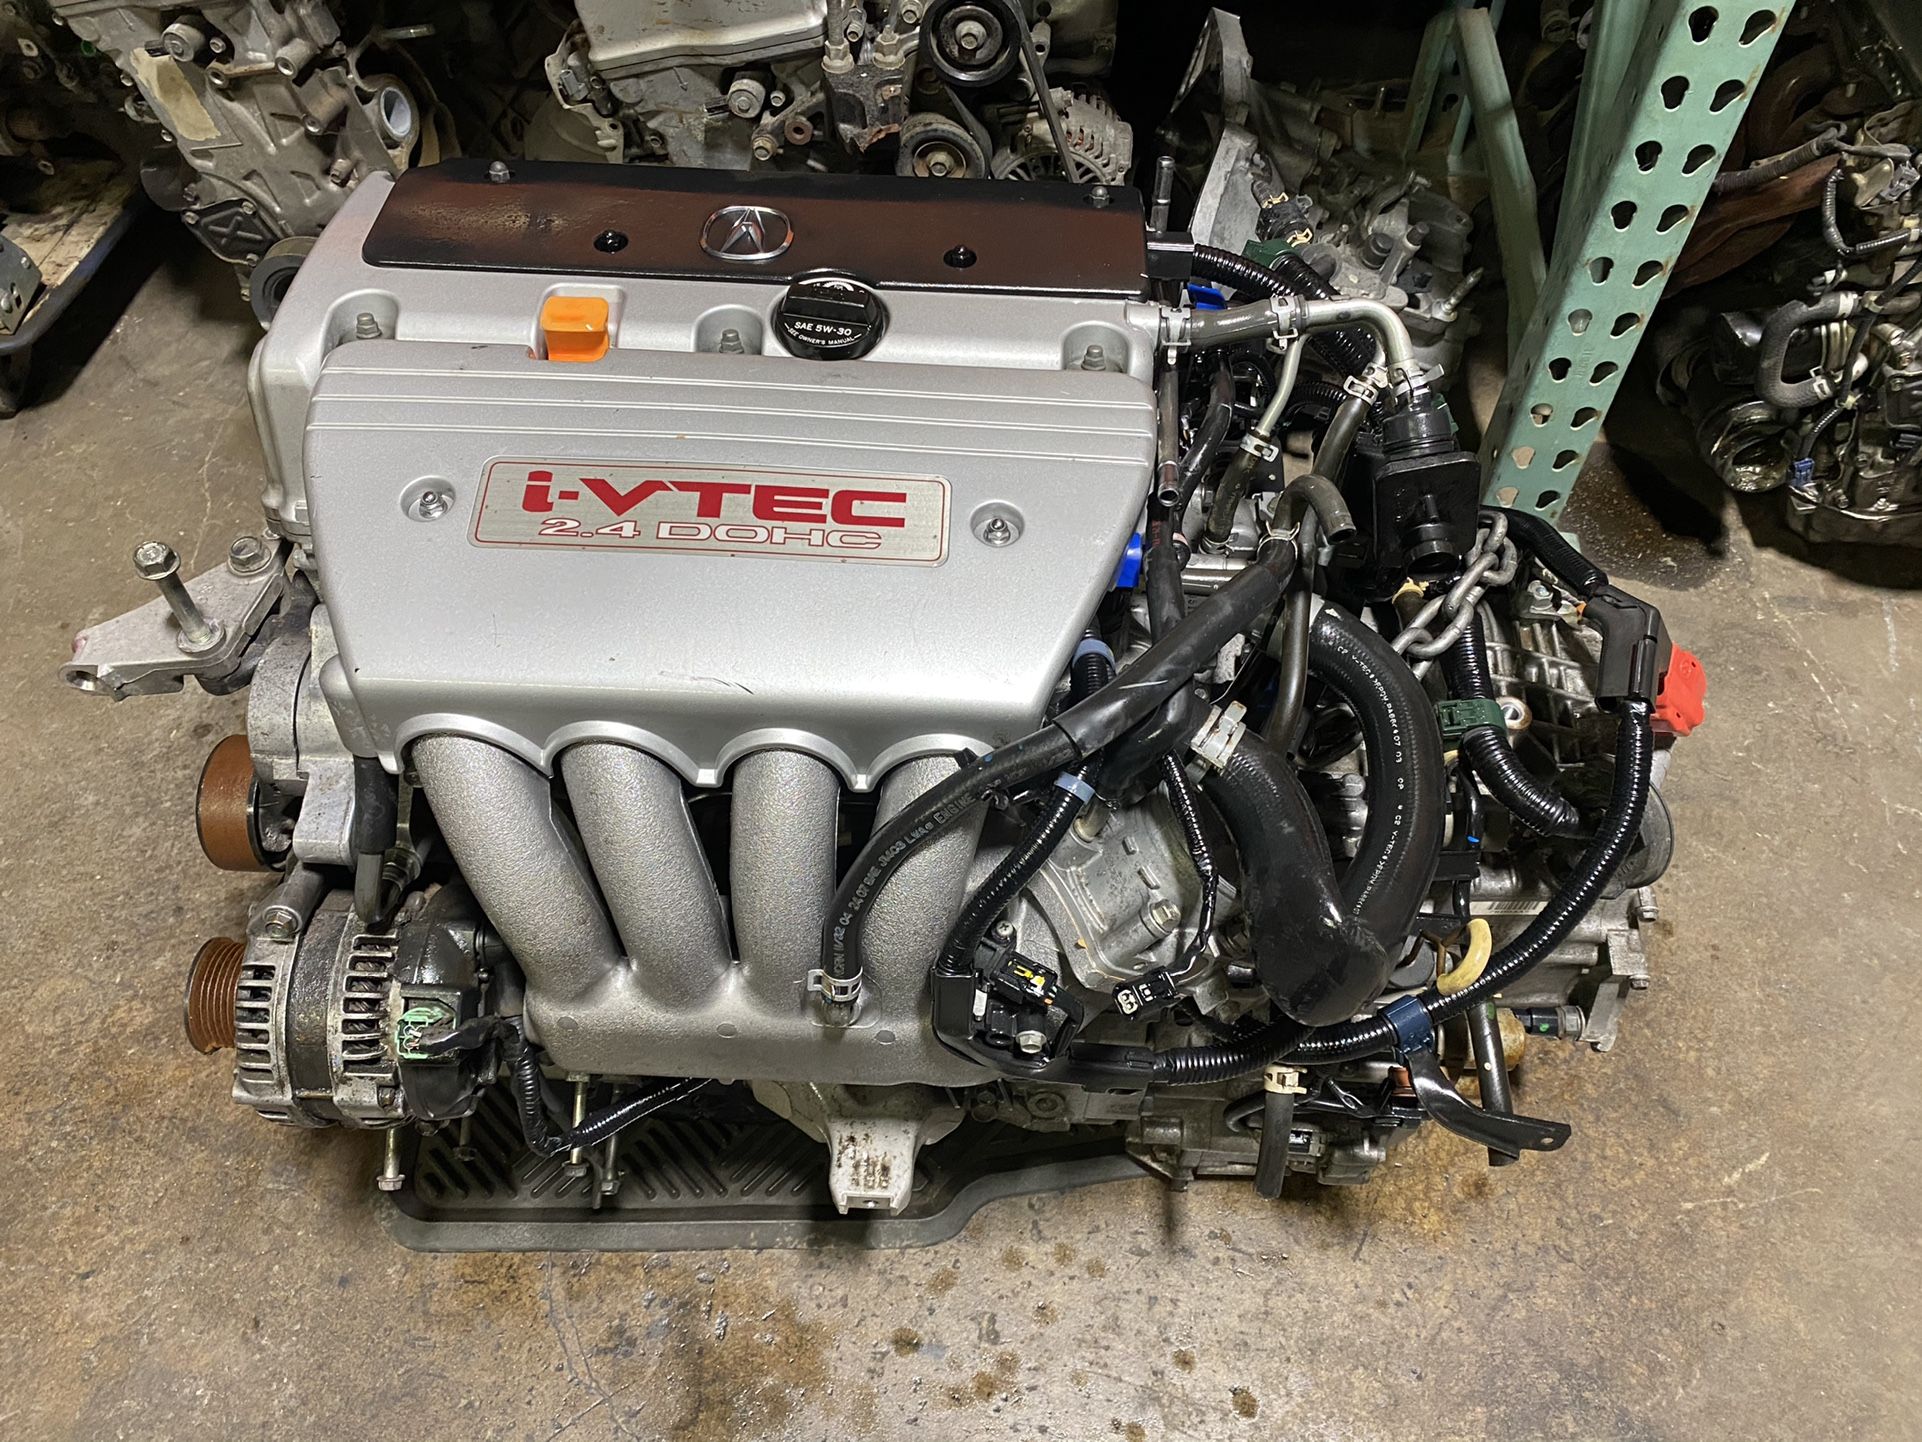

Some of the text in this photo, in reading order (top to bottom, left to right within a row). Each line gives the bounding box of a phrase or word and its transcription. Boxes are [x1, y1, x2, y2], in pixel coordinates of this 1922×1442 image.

[787, 328, 855, 345] SEE OWNER'S MANUAL
[794, 321, 852, 337] SAE 5W-30
[522, 470, 907, 528] i-VTEC
[538, 517, 882, 550] 2.4 DOHC
[1393, 735, 1402, 747] 07
